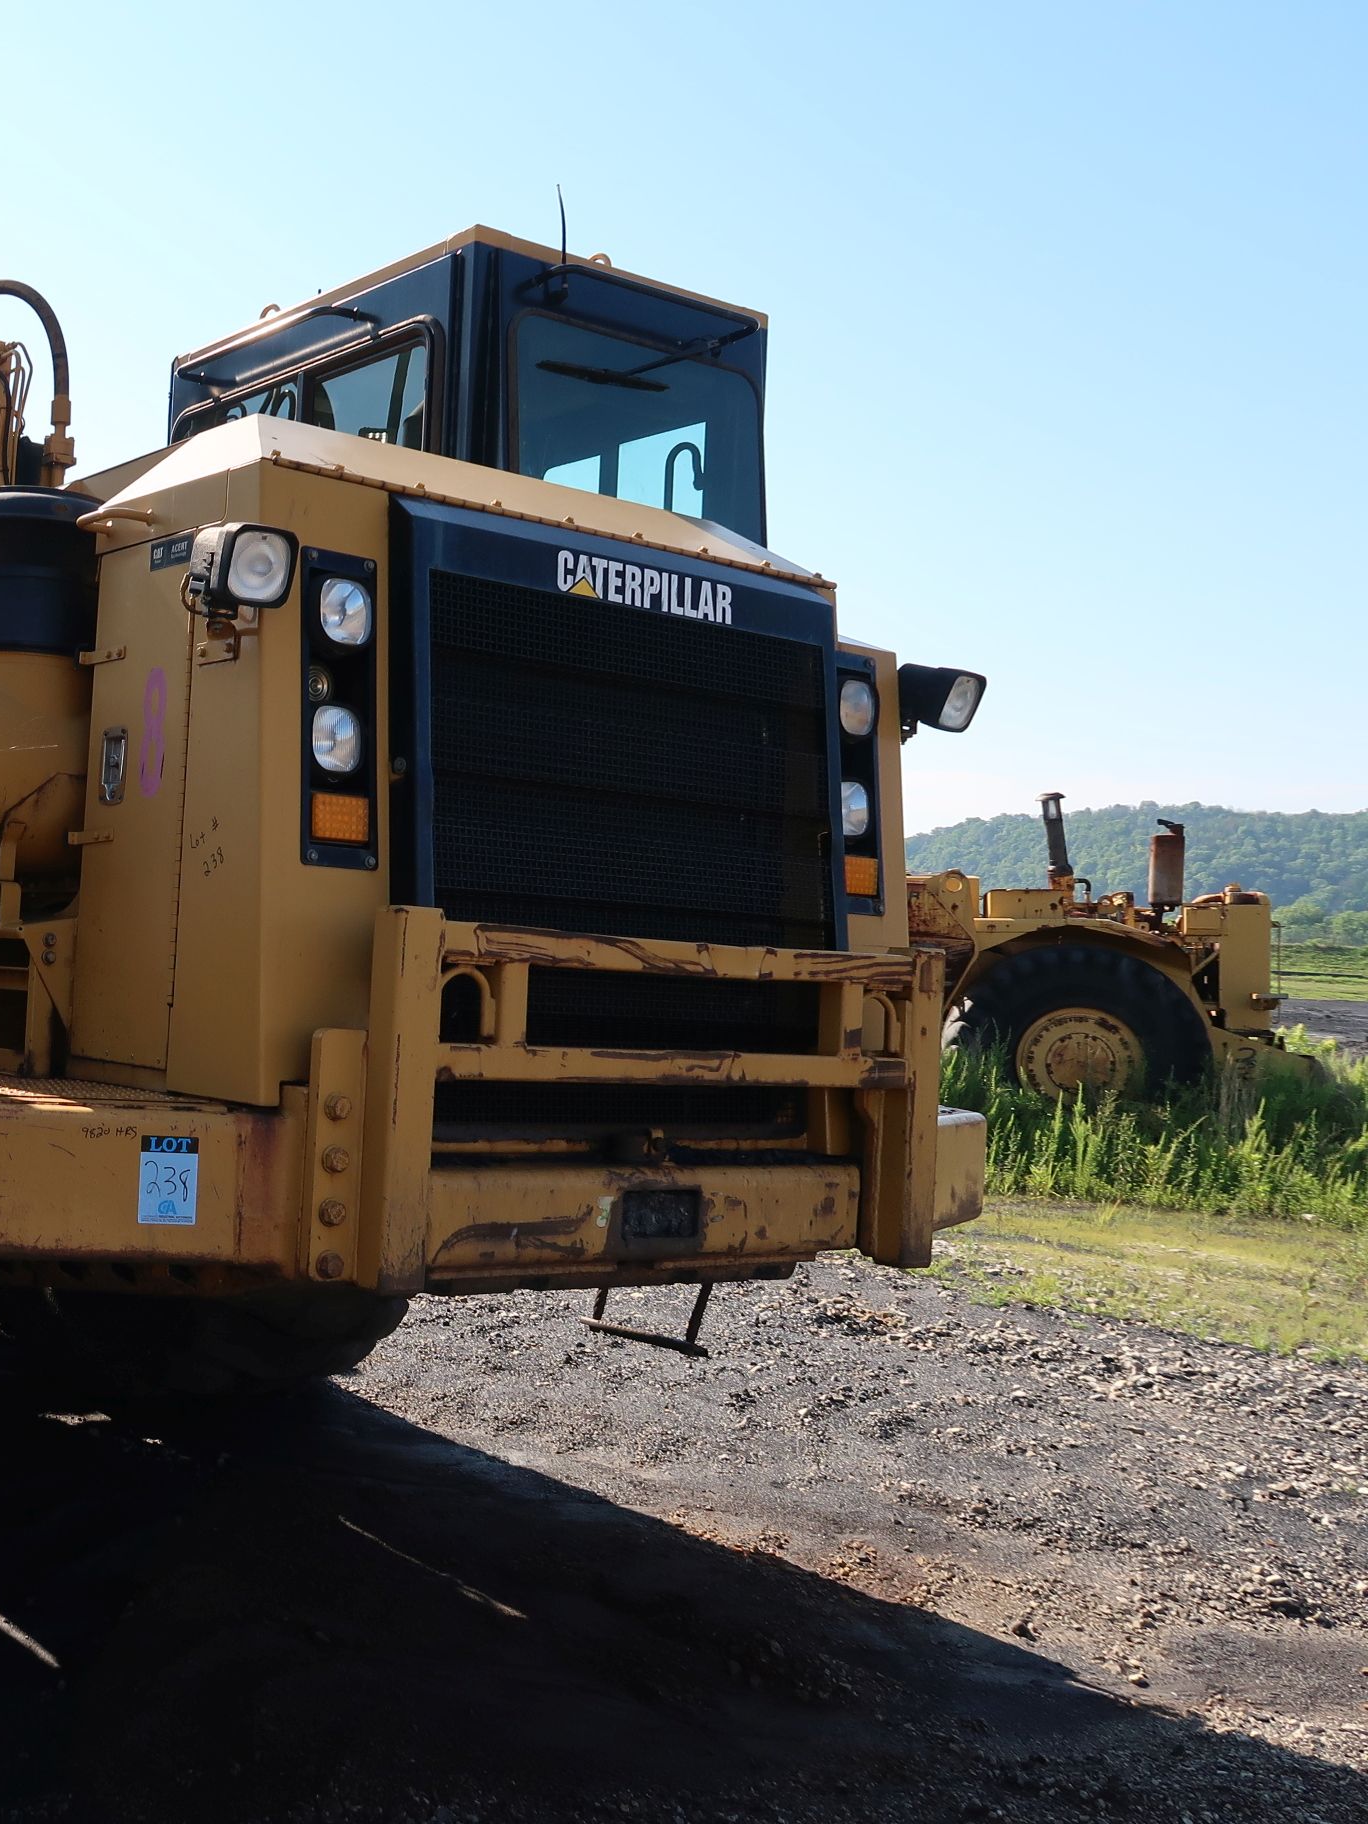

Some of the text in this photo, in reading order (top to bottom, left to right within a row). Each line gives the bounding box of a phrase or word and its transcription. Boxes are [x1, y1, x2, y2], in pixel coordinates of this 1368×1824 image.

[153, 546, 164, 559] CAT
[557, 550, 733, 625] CATERPILLAR
[202, 846, 225, 877] 238
[149, 1136, 192, 1153] LOT
[144, 1160, 191, 1202] 238
